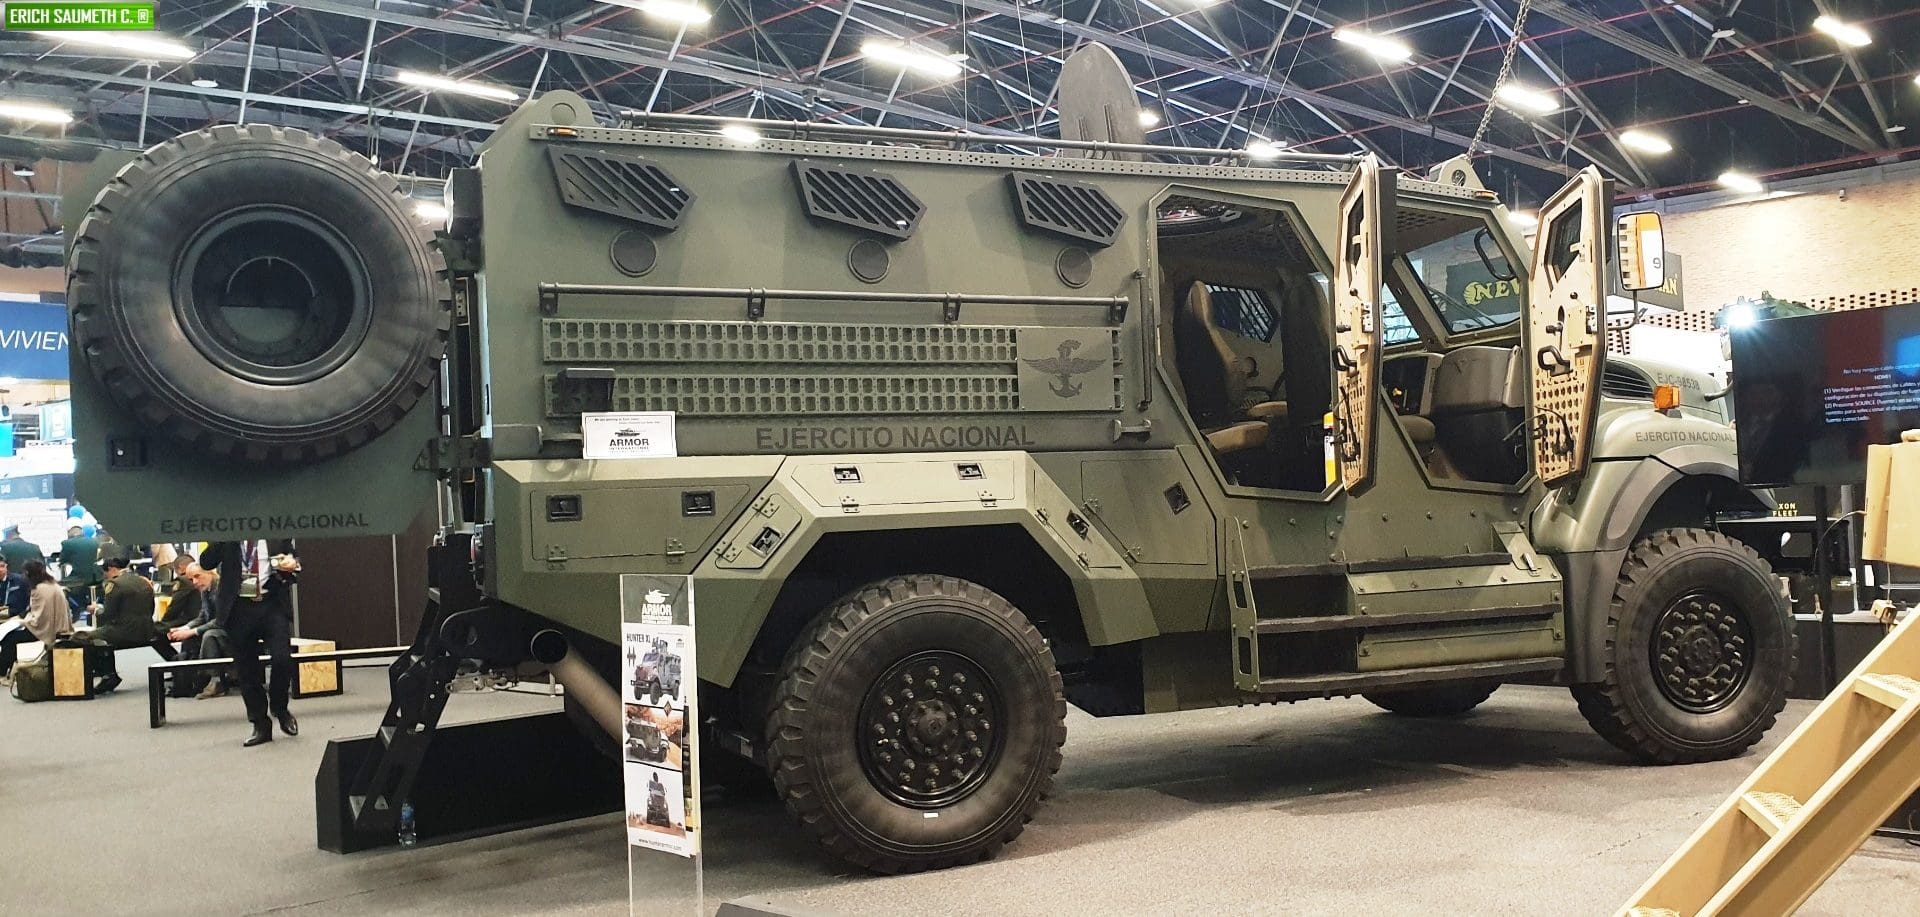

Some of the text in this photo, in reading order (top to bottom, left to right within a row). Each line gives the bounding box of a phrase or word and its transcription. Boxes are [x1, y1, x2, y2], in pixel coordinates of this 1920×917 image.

[609, 438, 650, 447] ARMOR
[902, 425, 1035, 448] NACIONAL
[1688, 431, 1736, 442] NACIONAL
[269, 512, 369, 531] NACIONAL
[641, 603, 673, 617] ARMOR
